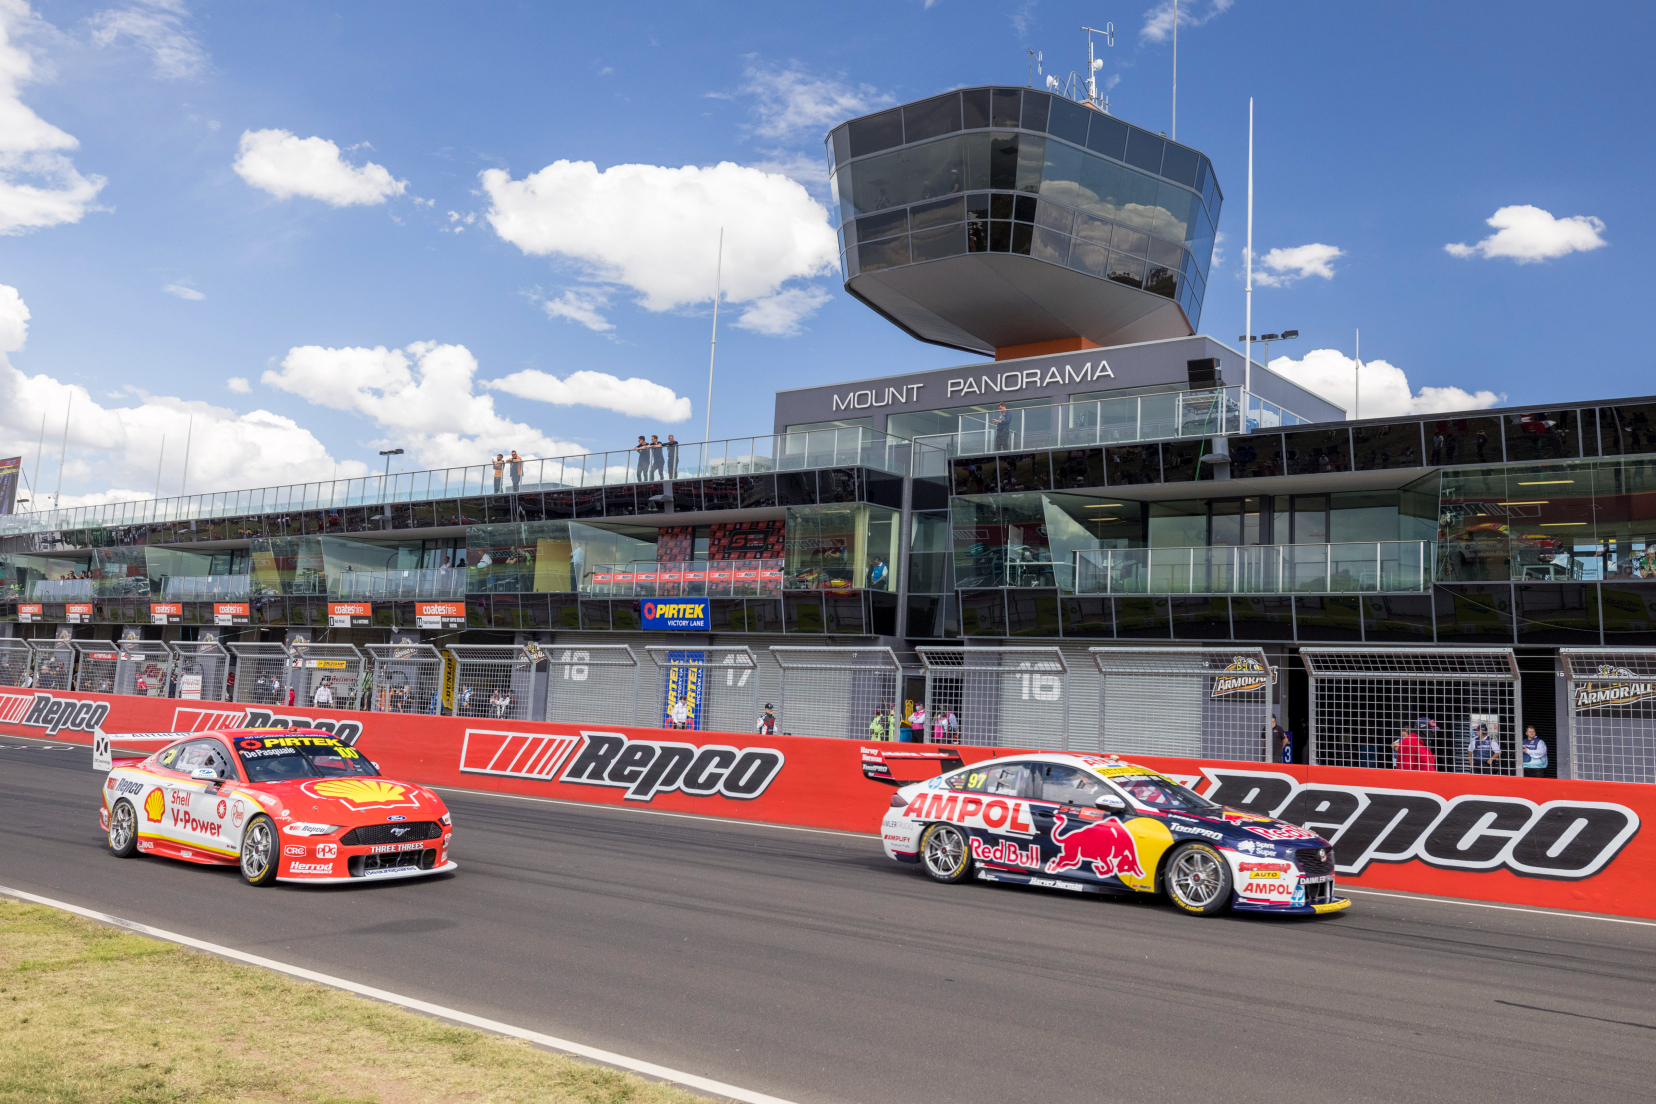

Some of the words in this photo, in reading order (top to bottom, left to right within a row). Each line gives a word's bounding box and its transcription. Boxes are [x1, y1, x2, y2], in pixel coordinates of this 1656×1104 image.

[832, 384, 924, 412] MOUNT
[948, 360, 1115, 398] PANORAMA
[656, 604, 705, 618] PIRTEK
[722, 654, 757, 688] 17
[686, 658, 698, 718] PIRTEK
[1016, 661, 1061, 700] 16
[1578, 686, 1630, 706] ARMOR
[1630, 684, 1654, 696] ALL
[22, 692, 110, 736] Repco
[264, 738, 344, 748] PIRTEK
[860, 746, 879, 756] Harvey
[258, 747, 296, 757] Pasquale
[333, 746, 359, 758] 100
[862, 754, 882, 762] Norman
[1285, 746, 1292, 762] 3
[559, 731, 786, 801] Repco
[862, 764, 888, 772] ToolPRO
[115, 778, 144, 795] Repco
[967, 773, 987, 789] 97
[171, 790, 191, 807] Shell
[902, 792, 1030, 832] AMPOL
[171, 808, 222, 838] V-Power
[1170, 822, 1223, 840] ToolPRO
[1199, 766, 1641, 881] Repco
[887, 834, 910, 843] AMPLIFY
[1256, 841, 1275, 850] Spirit
[370, 845, 396, 853] THREE
[397, 842, 424, 852] THREES
[970, 836, 1004, 863] Red
[1005, 840, 1040, 868] Bull
[1256, 849, 1277, 857] Super
[290, 861, 333, 870] Herrod
[1029, 877, 1054, 887] Harvey
[1055, 880, 1083, 892] Norman
[1243, 883, 1292, 895] AMPOL
[1300, 877, 1325, 885] DAIMLER
